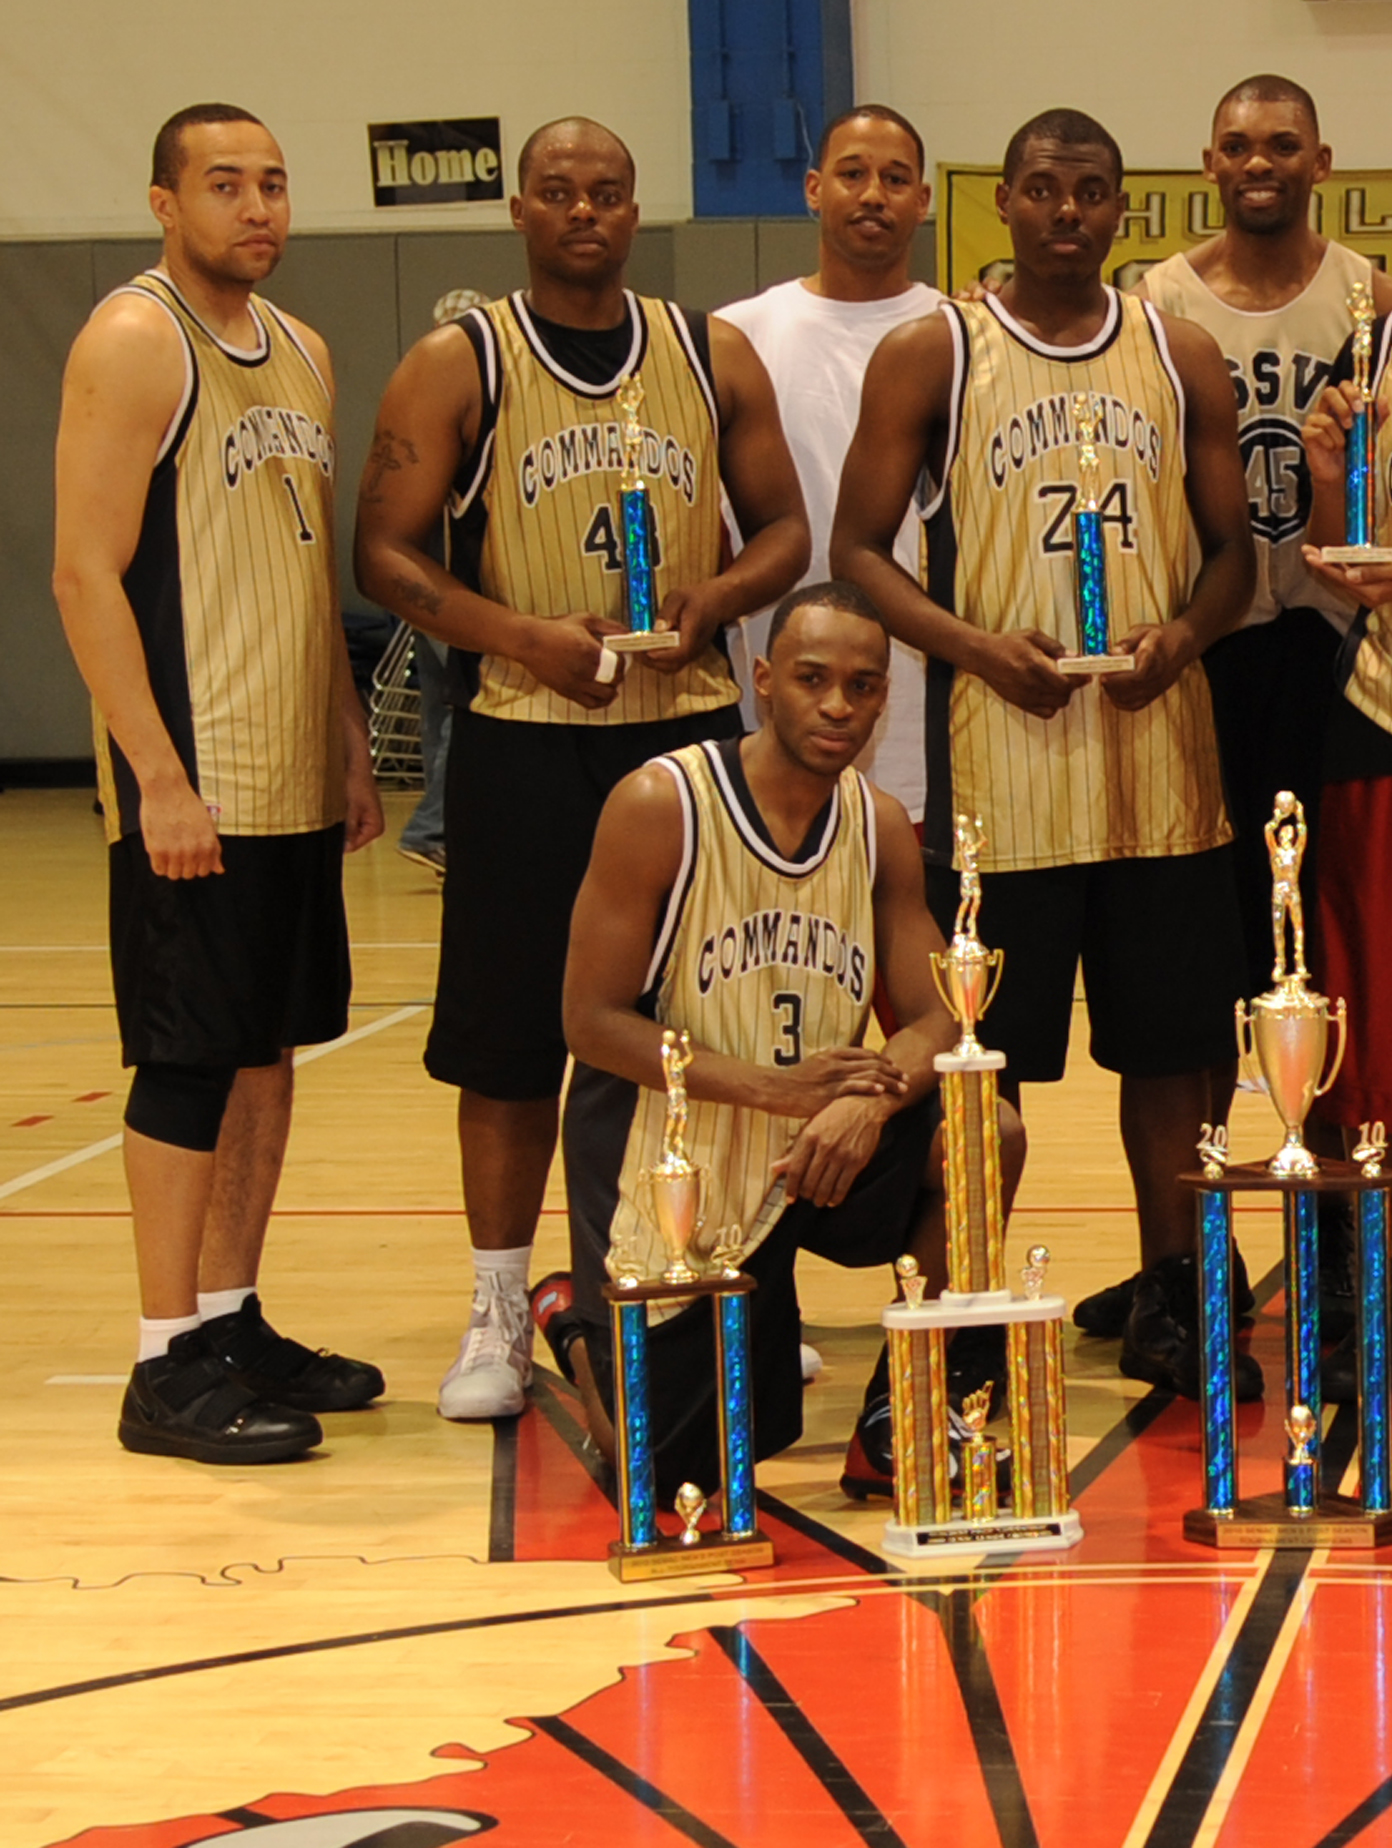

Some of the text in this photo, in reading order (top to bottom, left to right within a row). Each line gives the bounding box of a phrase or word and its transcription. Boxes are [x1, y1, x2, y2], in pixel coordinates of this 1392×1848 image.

[372, 139, 499, 188] Home
[520, 422, 696, 509] COMMADOS
[990, 390, 1162, 492] COMMNDOS
[282, 474, 316, 544] 1
[1033, 478, 1138, 557] 24
[1245, 445, 1301, 518] 45
[581, 502, 663, 573] 4
[696, 907, 867, 1006] COMMANDOS
[769, 990, 803, 1068] 3
